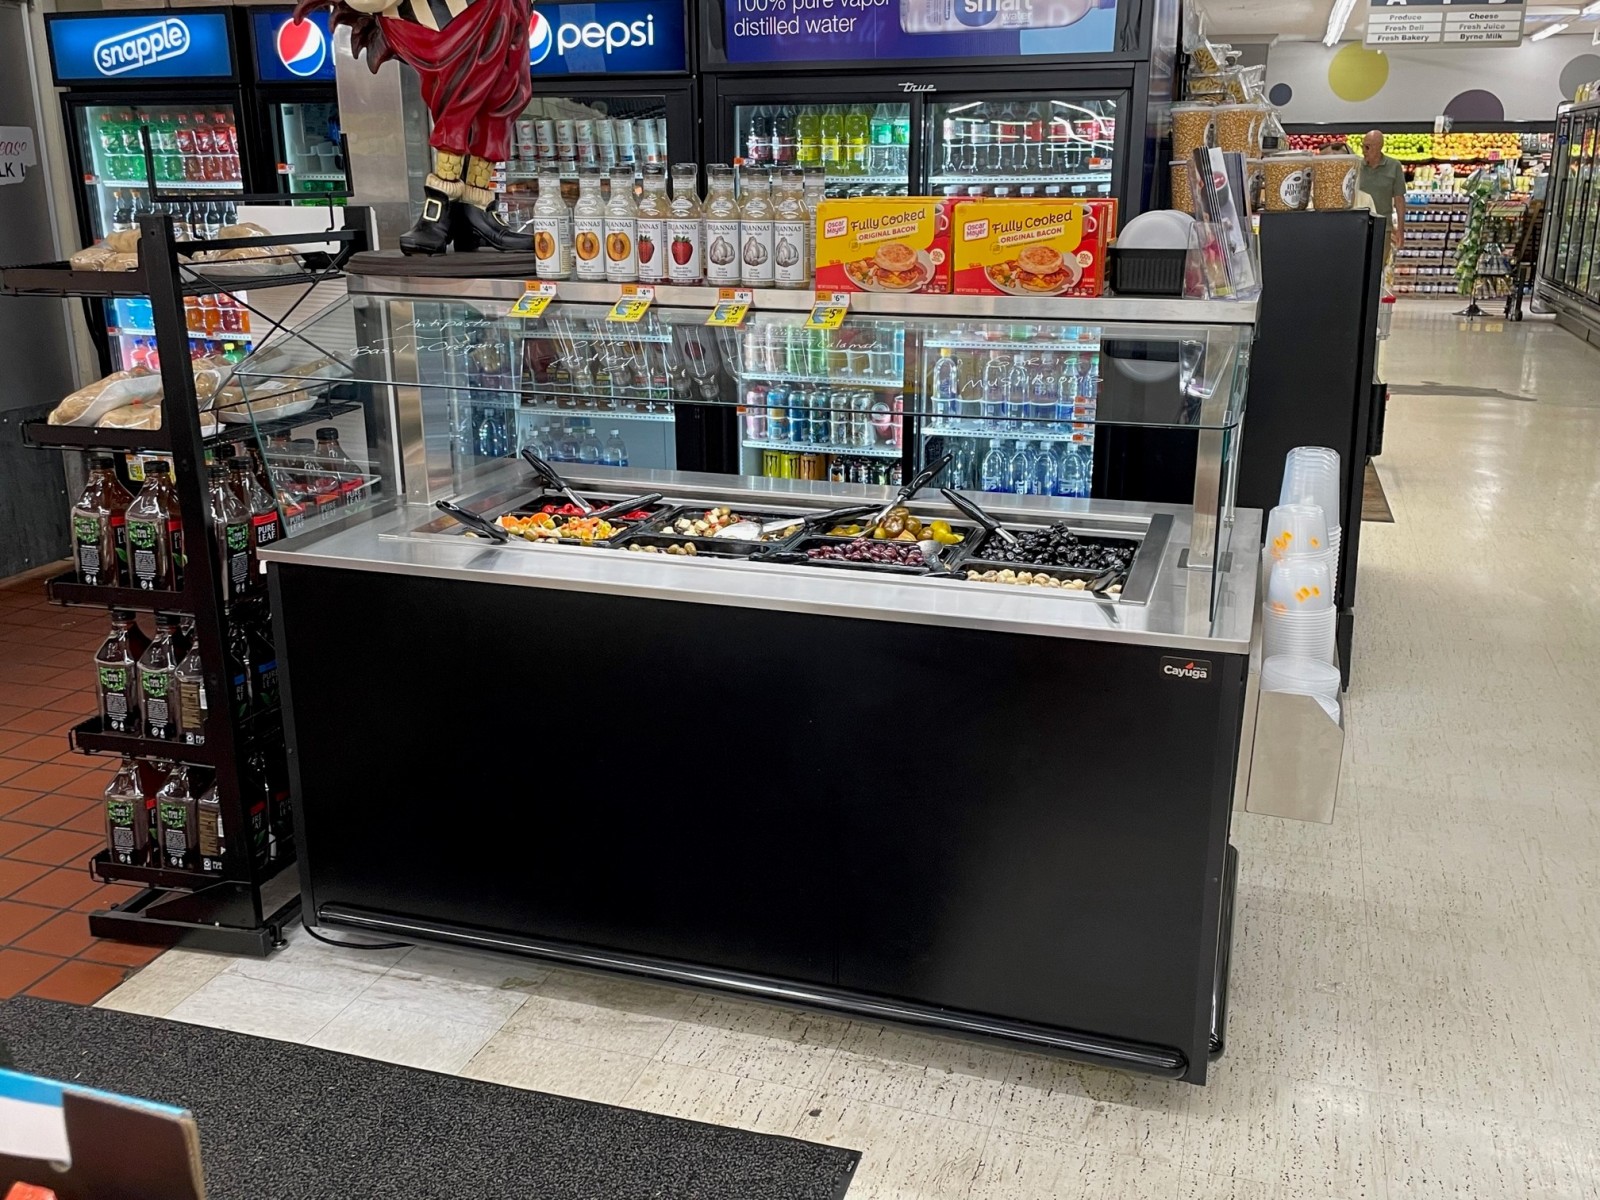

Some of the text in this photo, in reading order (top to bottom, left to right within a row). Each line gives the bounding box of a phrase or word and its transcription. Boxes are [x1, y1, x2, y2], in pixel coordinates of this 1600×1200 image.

[793, 0, 833, 14] pure
[841, 0, 889, 11] vapor
[734, 15, 857, 37] distilled water
[557, 14, 654, 55] pepsi
[1401, 34, 1430, 42] Bakery
[100, 20, 184, 68] snapple
[850, 208, 926, 232] Fully Cooked
[992, 209, 1073, 234] Fully Cooked
[858, 230, 891, 241] ORIGINAL
[892, 225, 916, 236] BACON
[1000, 233, 1035, 244] ORIGINAL
[1036, 227, 1062, 238] BACON
[257, 522, 276, 534] PURE
[258, 531, 276, 544] LEAF
[1163, 664, 1208, 680] Cayuga
